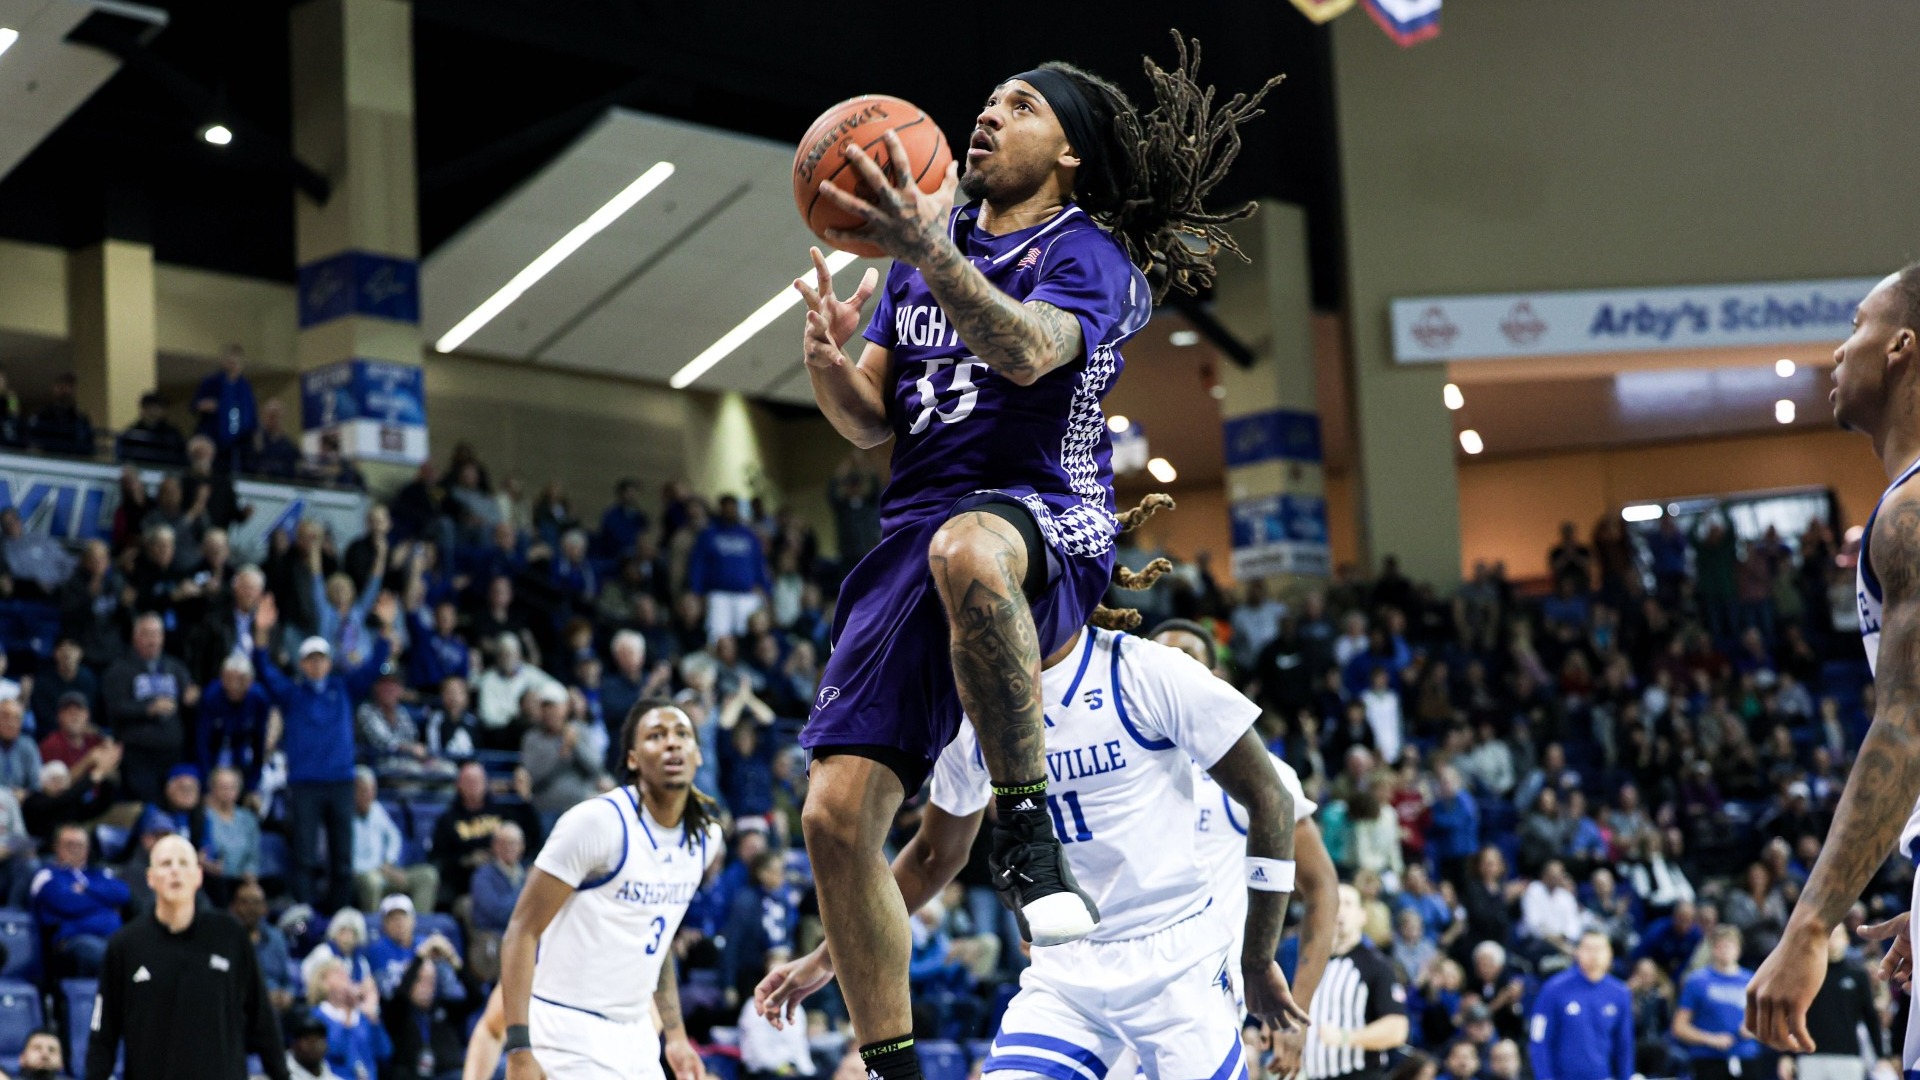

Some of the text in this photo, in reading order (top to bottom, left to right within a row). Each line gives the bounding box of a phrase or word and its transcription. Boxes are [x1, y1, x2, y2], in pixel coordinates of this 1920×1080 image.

[1590, 302, 1710, 341] Arby's
[1047, 790, 1093, 844] 11
[645, 915, 666, 955] 3
